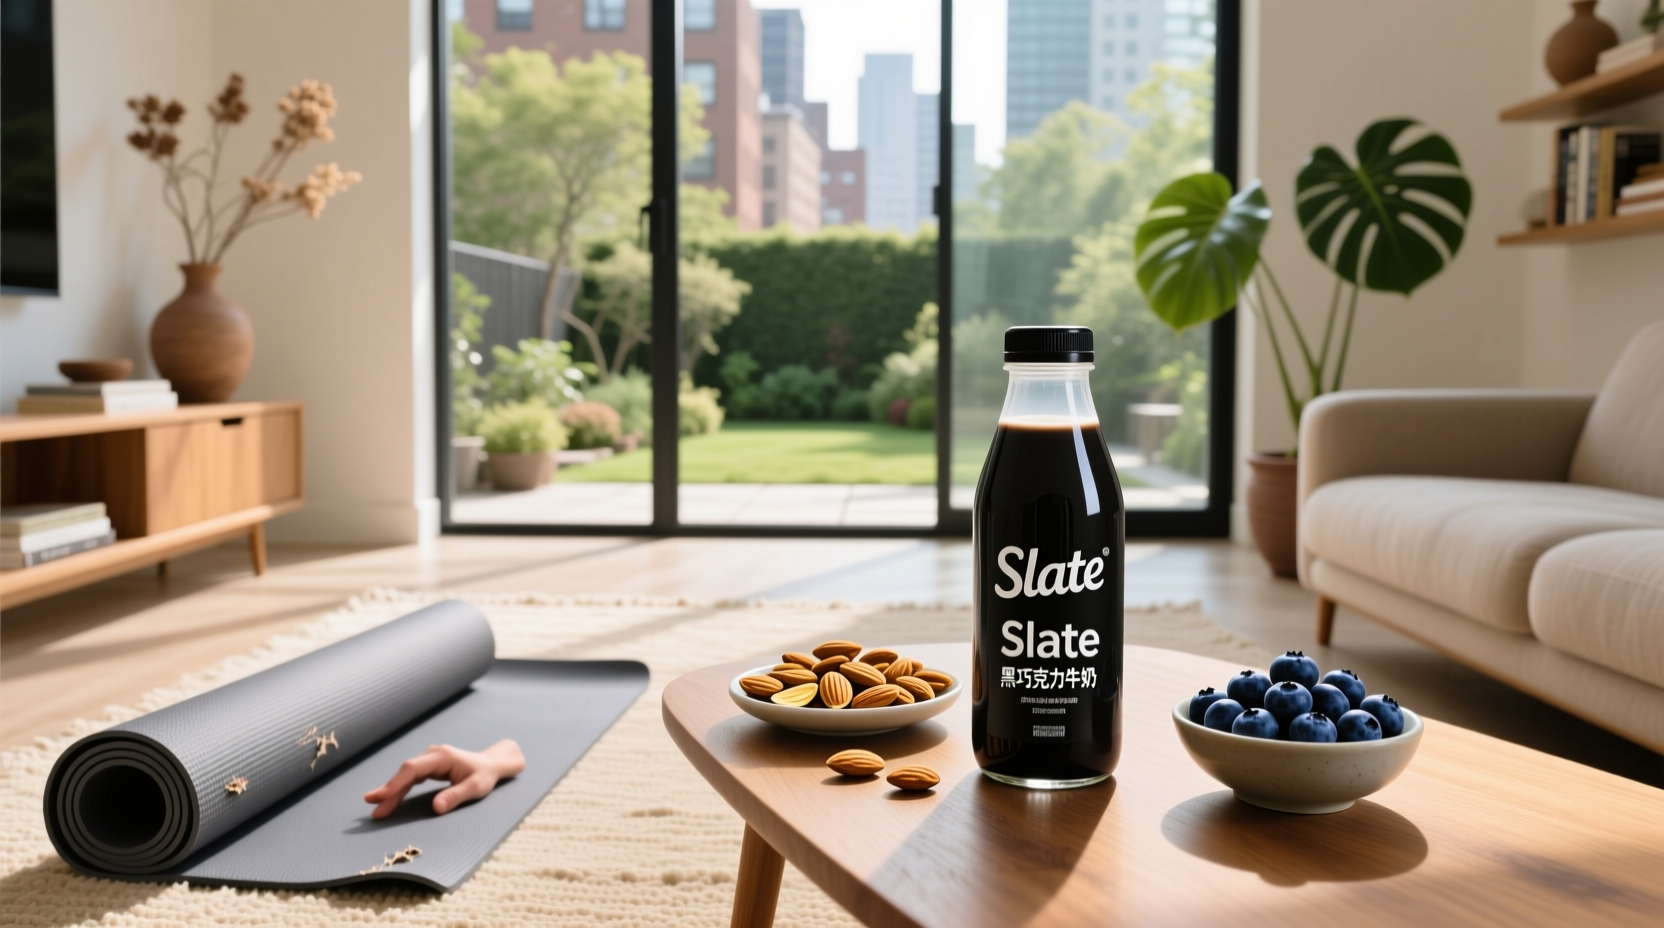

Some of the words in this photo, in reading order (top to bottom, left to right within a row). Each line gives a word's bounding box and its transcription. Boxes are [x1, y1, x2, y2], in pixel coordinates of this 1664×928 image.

[1001, 620, 1100, 658] Slate
[1001, 666, 1097, 689] 黑巧克力牛奶
